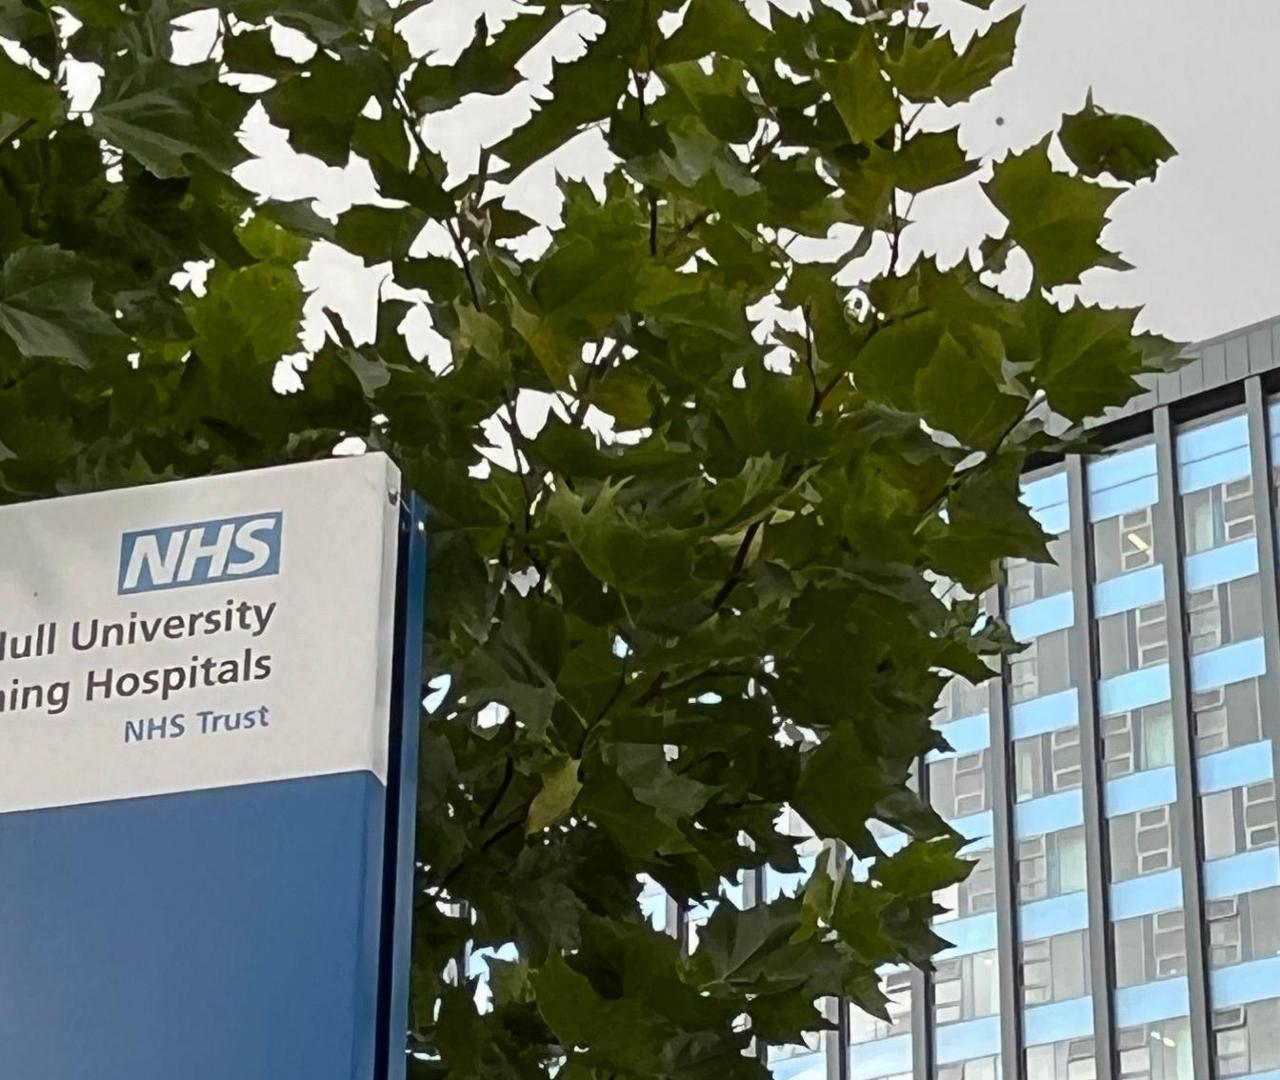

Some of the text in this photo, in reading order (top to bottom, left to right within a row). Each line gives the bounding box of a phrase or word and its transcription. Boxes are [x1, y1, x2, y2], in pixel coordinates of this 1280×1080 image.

[123, 517, 277, 591] NHS
[71, 600, 277, 651] University
[86, 648, 272, 704] Hospitals
[123, 705, 270, 744] NHS Trust
